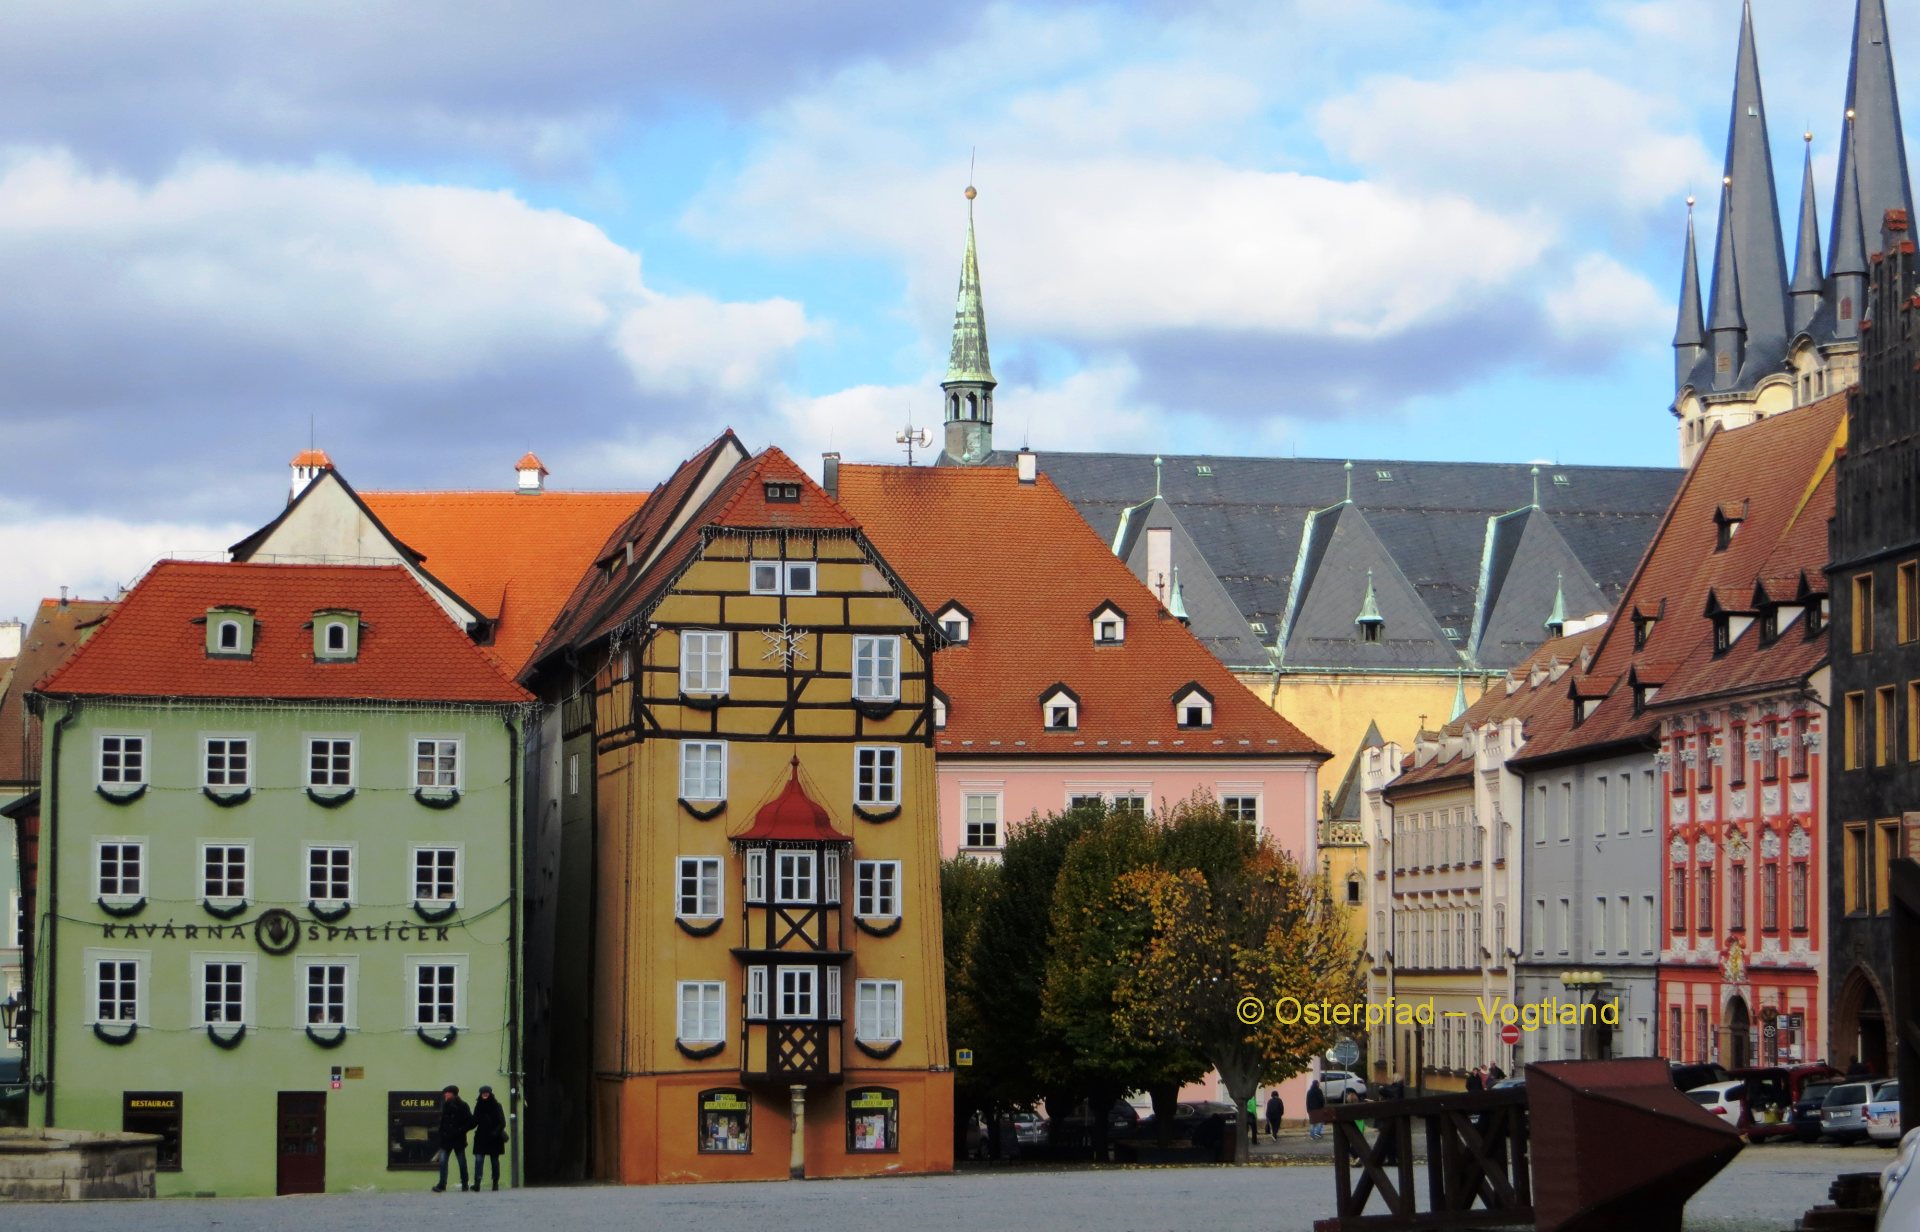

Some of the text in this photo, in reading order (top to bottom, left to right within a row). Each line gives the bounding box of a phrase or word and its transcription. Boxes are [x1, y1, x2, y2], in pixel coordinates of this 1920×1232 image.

[103, 918, 449, 941] KAVÁRNA ŠPALÍČEK
[131, 1100, 175, 1108] RESTAURACE
[400, 1099, 434, 1107] CAFE BAR
